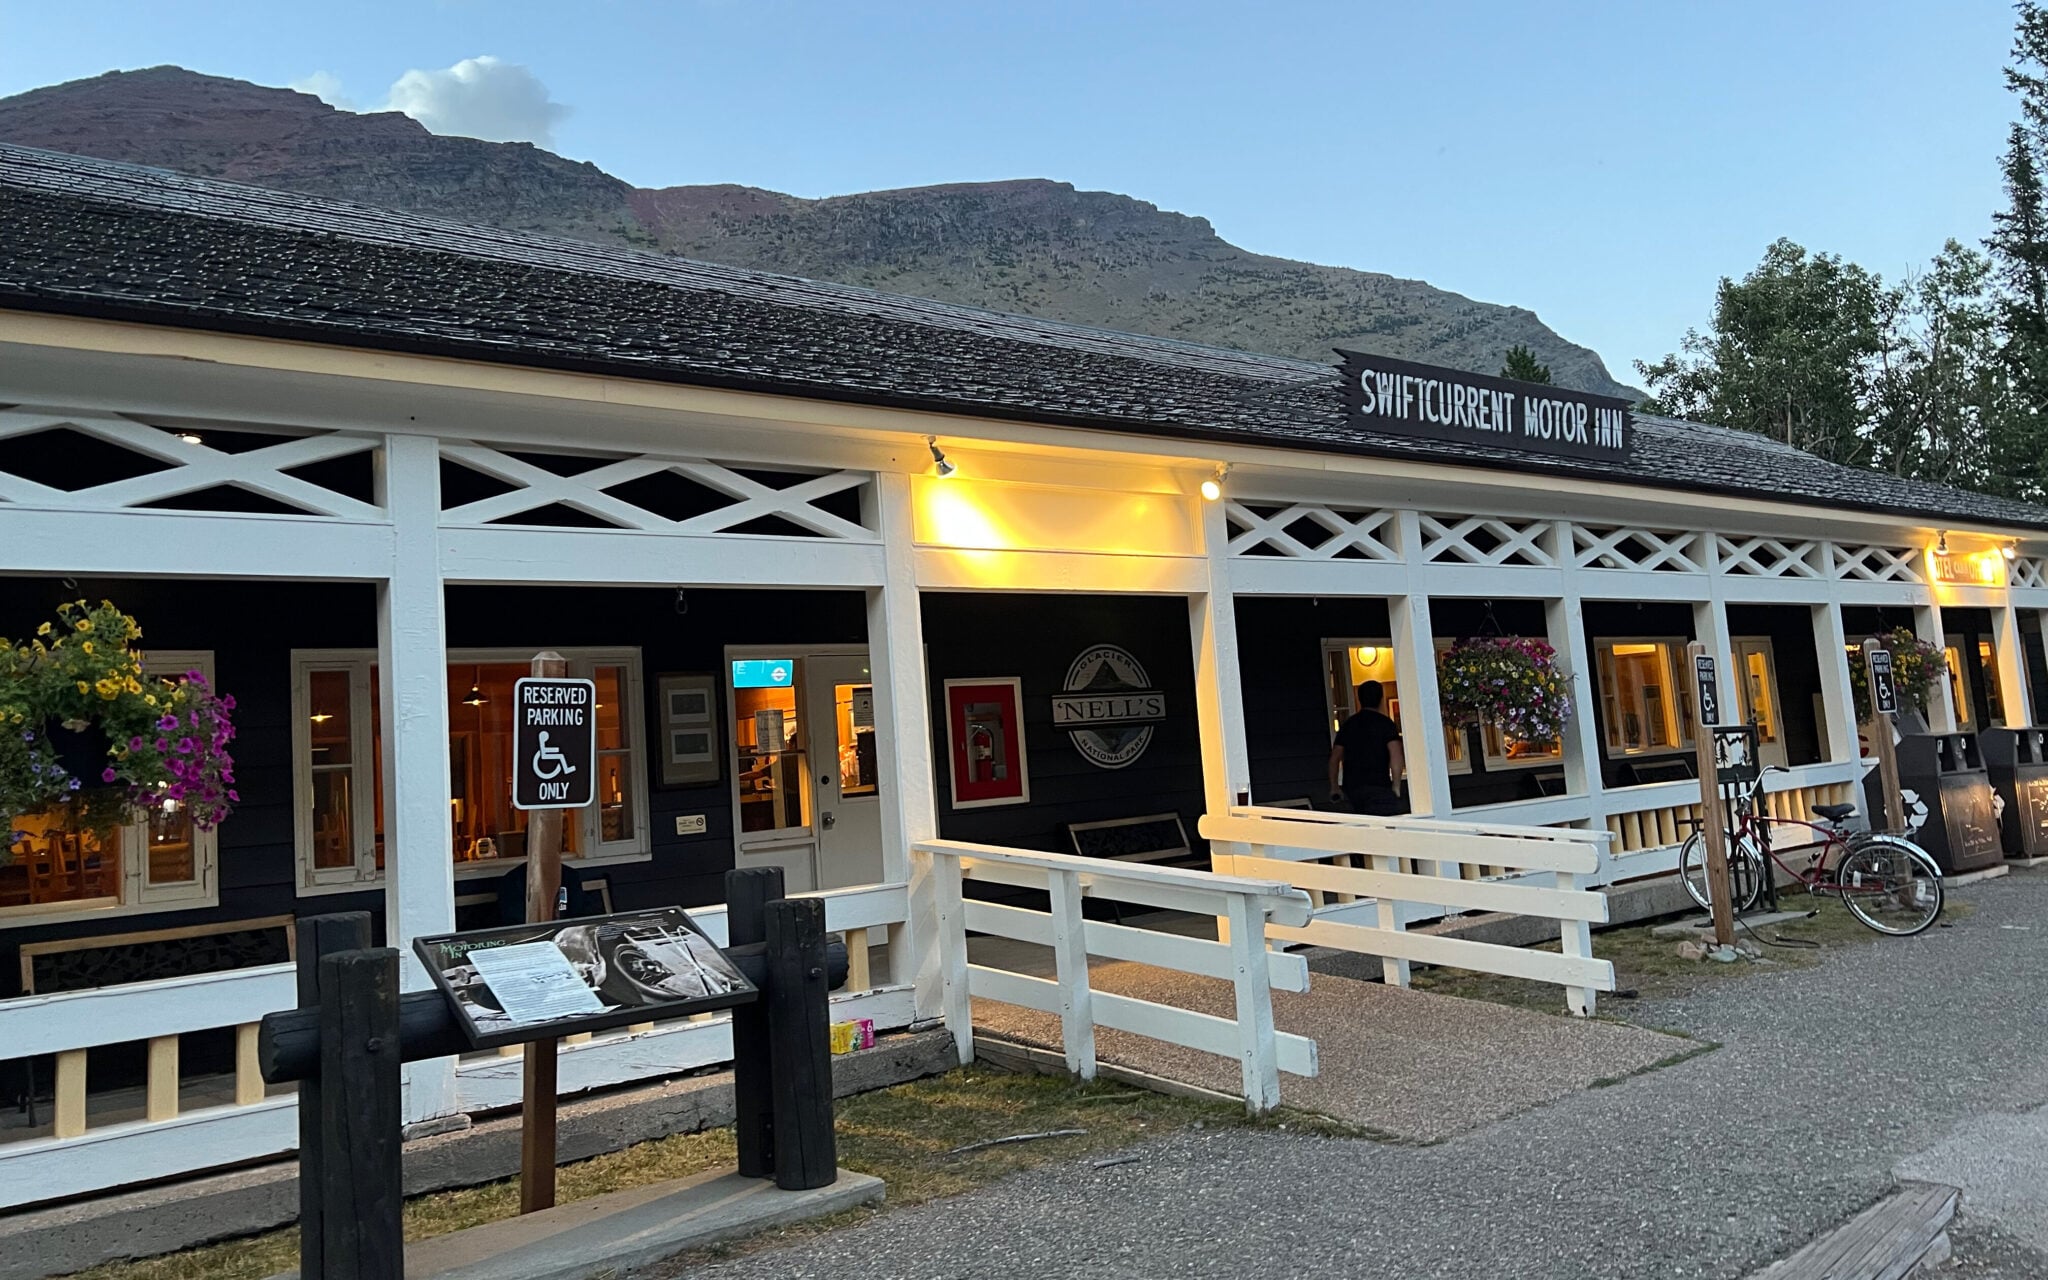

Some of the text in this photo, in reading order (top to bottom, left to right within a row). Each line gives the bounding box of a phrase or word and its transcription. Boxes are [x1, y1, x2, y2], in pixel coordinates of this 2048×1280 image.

[1361, 368, 1623, 449] SWIFTCURRENT MOTOR INN
[1079, 651, 1132, 670] GLACIER
[523, 686, 587, 705] RESERVED
[527, 708, 584, 726] PARKING
[1057, 698, 1161, 721] 'NELL'S
[1081, 736, 1144, 761] NATIONAL PARK
[539, 782, 570, 800] ONLY
[440, 940, 506, 954] MOTORING
